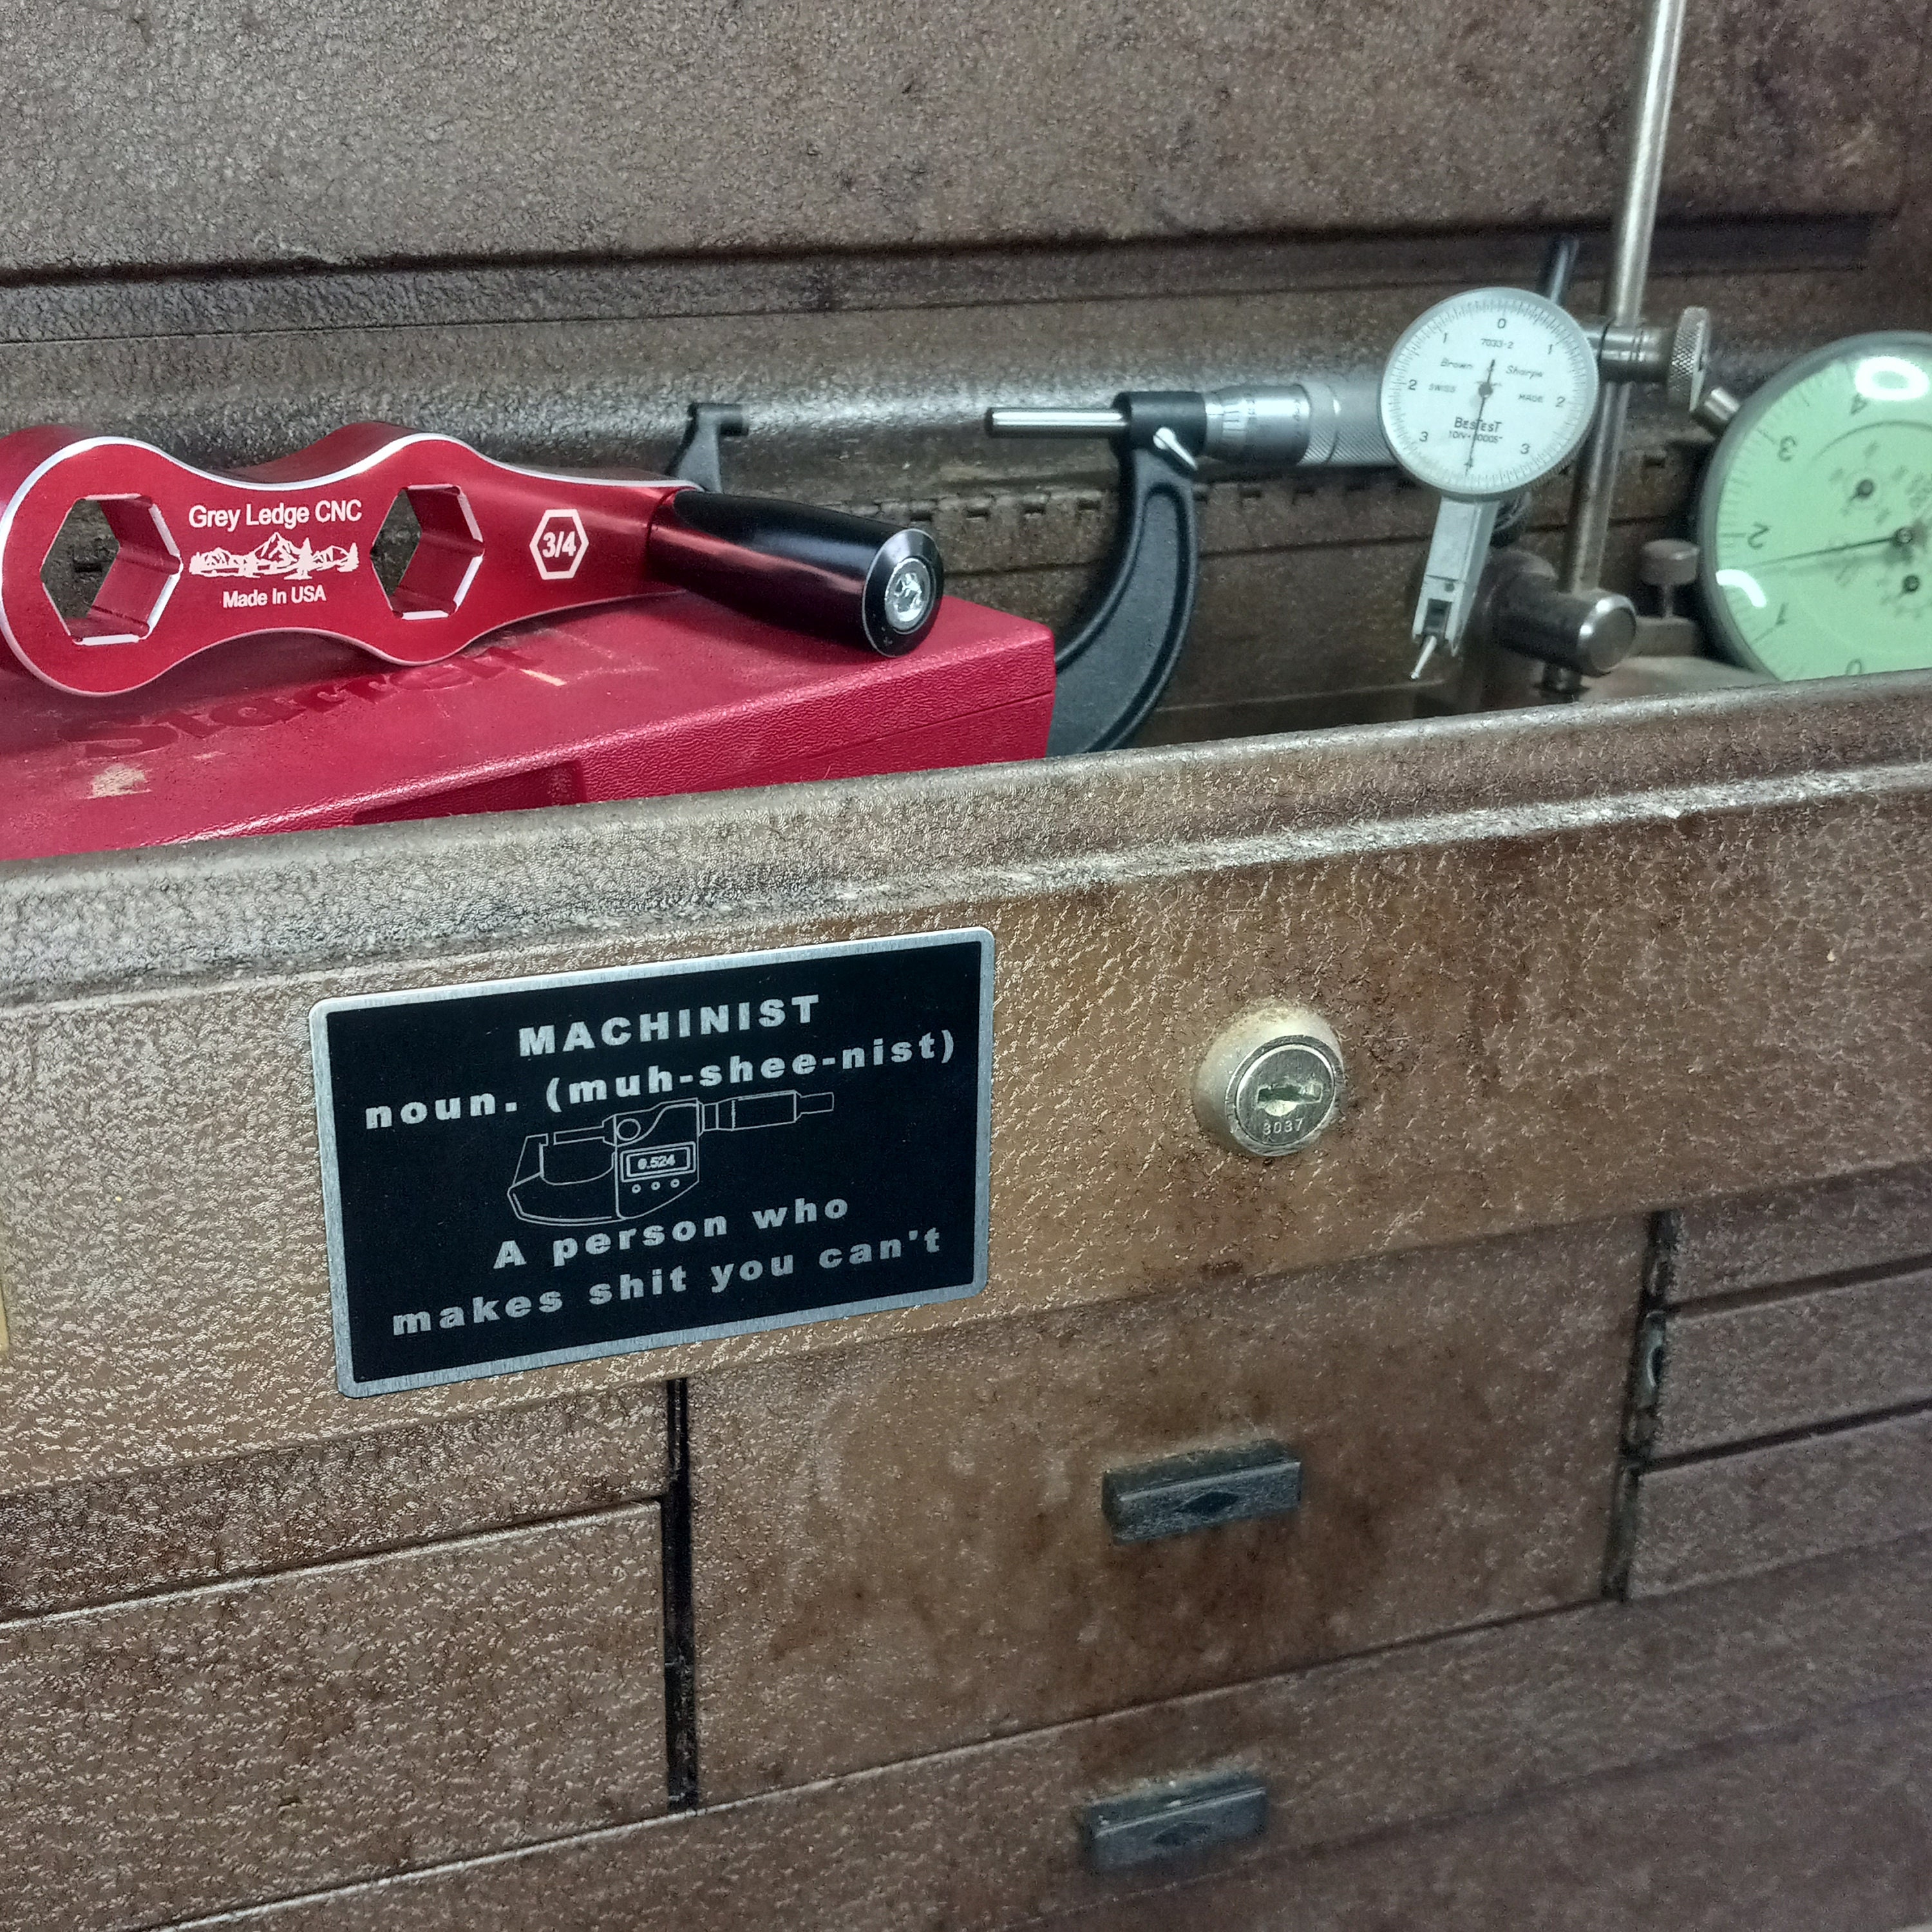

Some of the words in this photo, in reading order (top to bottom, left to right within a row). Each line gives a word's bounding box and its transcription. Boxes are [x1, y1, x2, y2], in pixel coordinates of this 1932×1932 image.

[1497, 318, 1506, 329] 0
[1442, 332, 1448, 343] 1
[1481, 338, 1514, 349] 7033-2
[1547, 344, 1553, 355] 1
[1440, 357, 1473, 370] Brown
[1506, 365, 1543, 379] Sharpe
[1408, 379, 1417, 391] 2
[1428, 383, 1456, 393] SWISS
[1518, 393, 1543, 403] MADE
[1555, 396, 1565, 407] 2
[1419, 431, 1428, 442] 3
[1520, 443, 1531, 455] 3
[1777, 435, 1797, 462] 3
[188, 504, 242, 533] Grey
[245, 502, 310, 530] Ledge
[314, 498, 363, 524] CNC
[542, 530, 577, 558] 3/4
[1747, 522, 1770, 549] 2
[223, 589, 269, 609] Made
[272, 587, 287, 605] In
[290, 584, 327, 604] USA
[518, 994, 820, 1057] MACHINIST
[365, 1089, 517, 1130] noun.
[546, 1030, 954, 1113] (muh-shee-nist)
[1263, 1117, 1305, 1136] 3037
[638, 1154, 676, 1170] 0.524
[493, 1240, 527, 1269] A
[553, 1215, 727, 1267] person
[752, 1196, 849, 1229] who
[393, 1291, 563, 1336] makes
[589, 1265, 686, 1306] shit
[710, 1255, 795, 1293] you
[818, 1227, 940, 1270] can't
